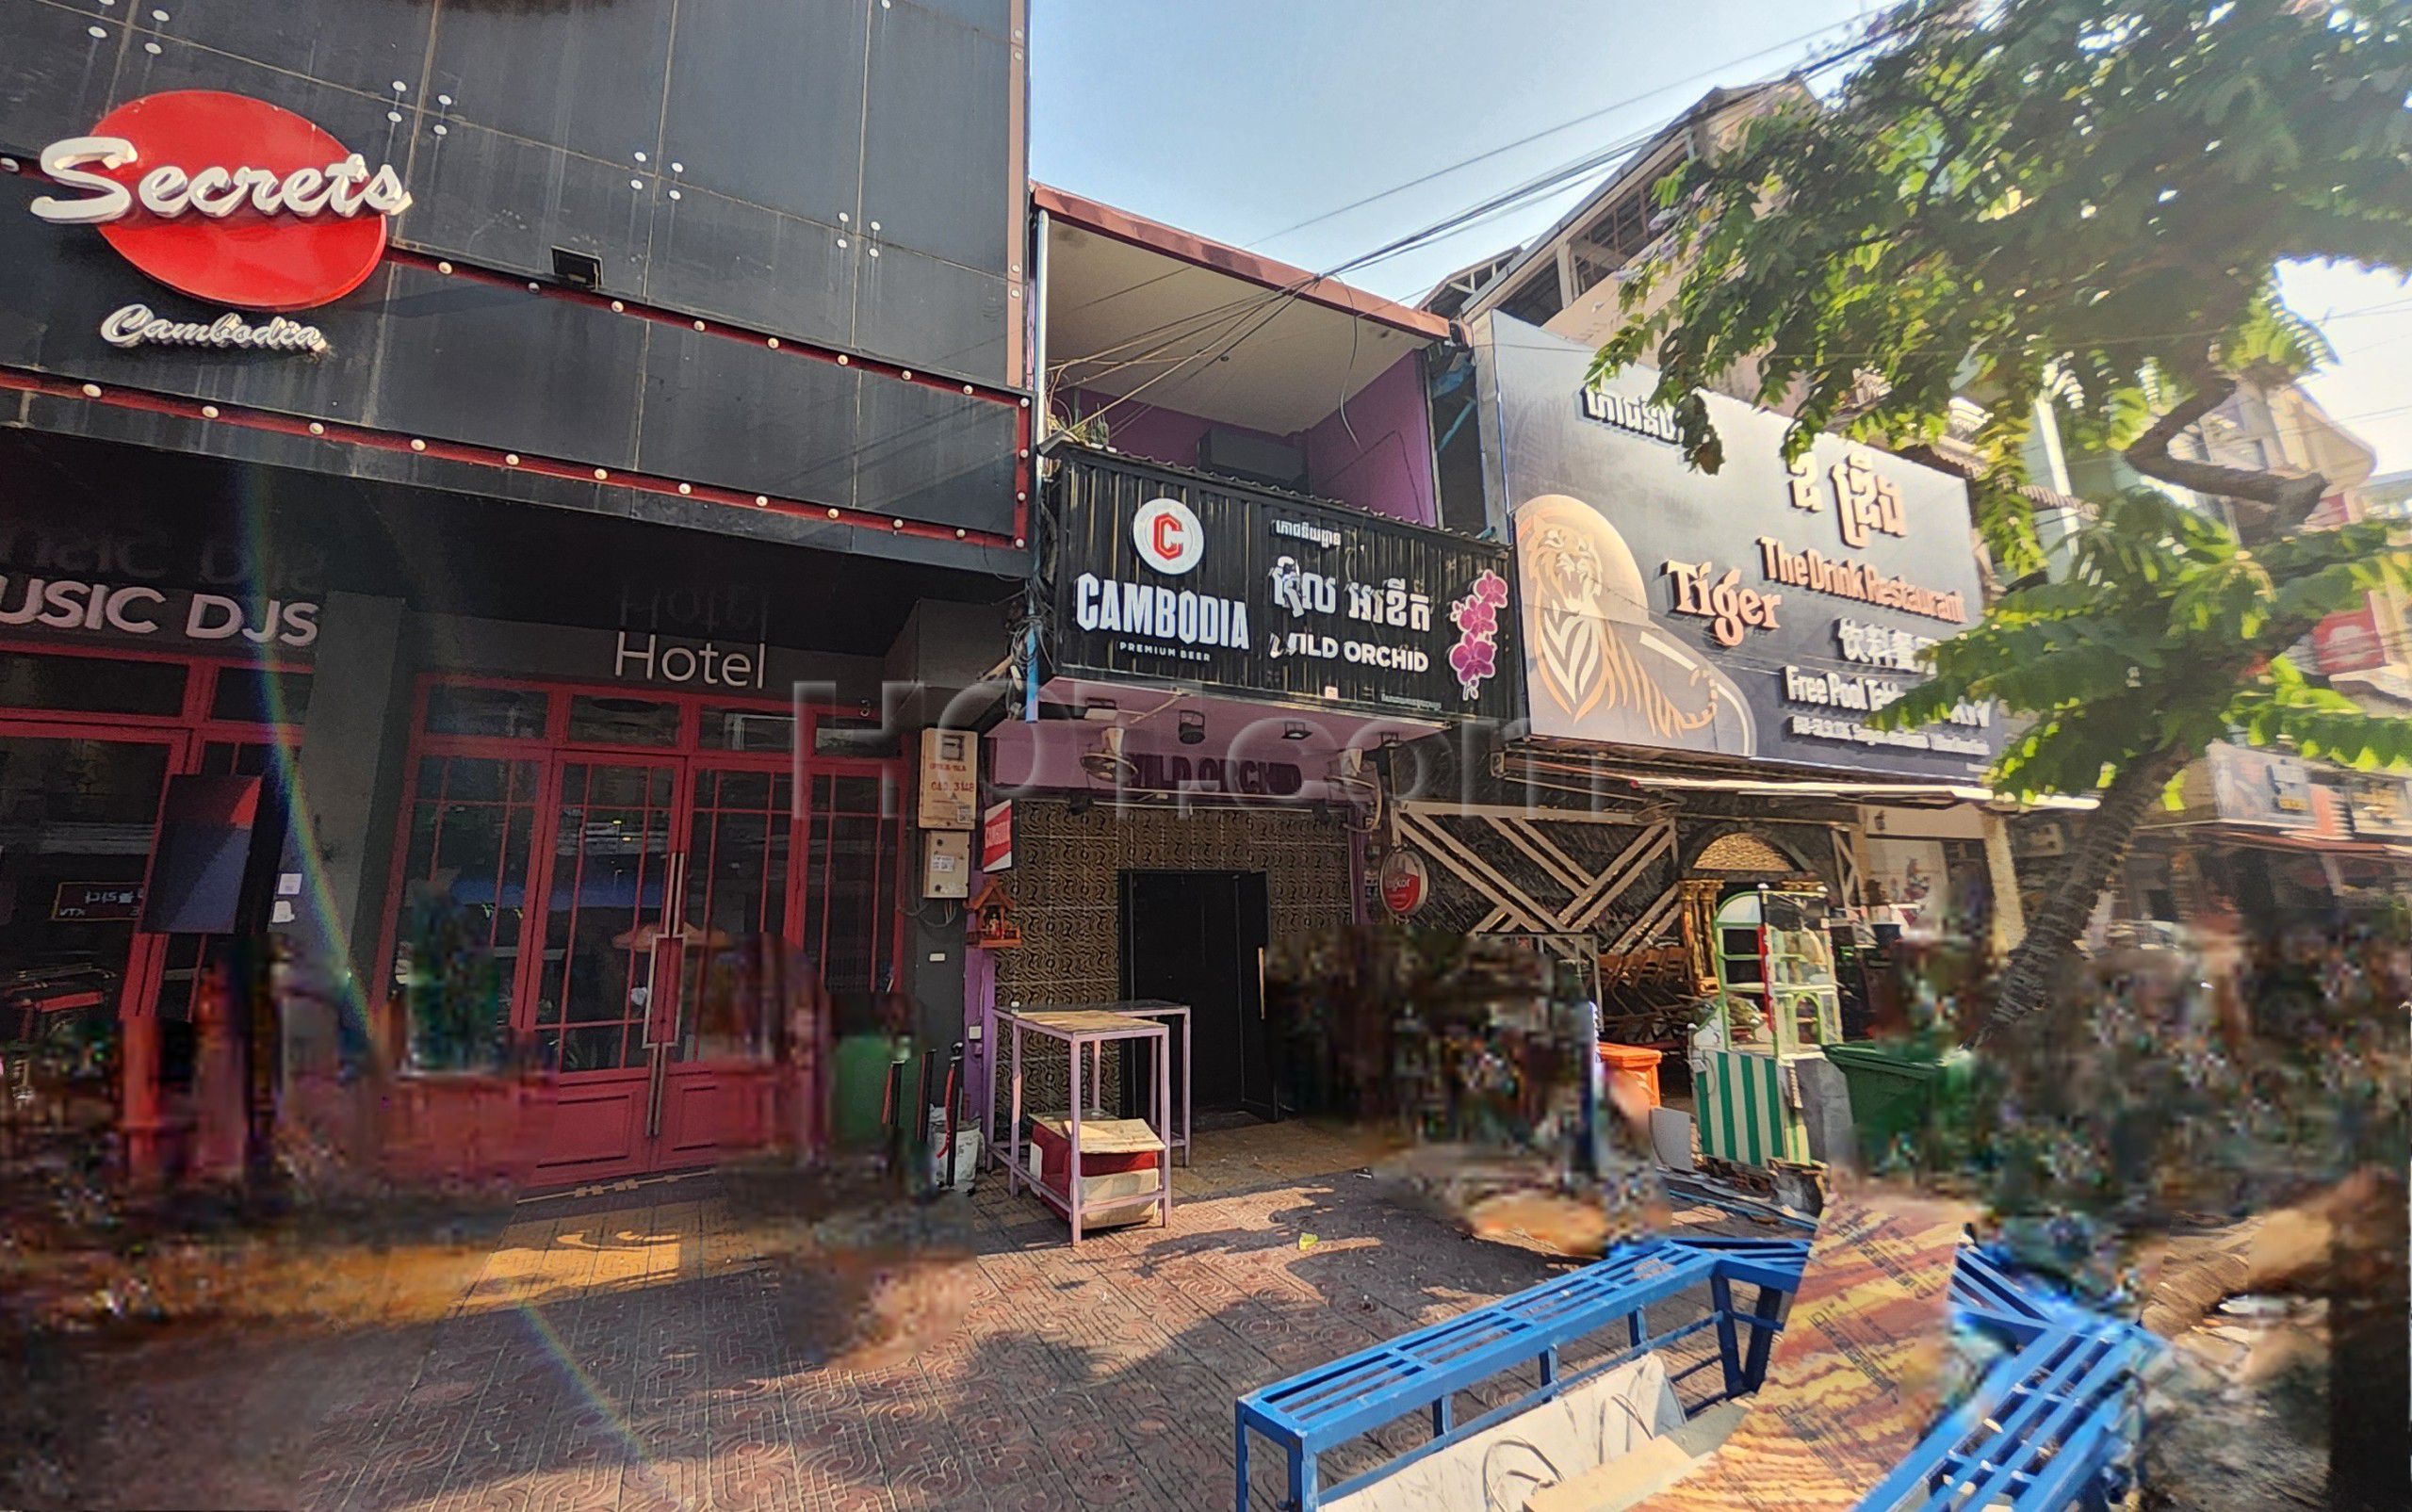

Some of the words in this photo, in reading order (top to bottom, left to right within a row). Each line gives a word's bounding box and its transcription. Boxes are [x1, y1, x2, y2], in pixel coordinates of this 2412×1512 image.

[30, 136, 412, 224] Secrets
[100, 303, 330, 354] Cambodia
[1667, 559, 1782, 647] Tiger
[1760, 536, 1809, 586] The
[1808, 548, 1869, 602] Drink
[1865, 564, 1969, 625] Restaurant
[186, 592, 320, 646] DJS
[1076, 572, 1250, 650] CAMBODIA
[614, 630, 766, 690] Hotel
[1119, 642, 1176, 657] PREMIUM
[1180, 649, 1211, 661] BEER
[1343, 641, 1429, 673] ORCHID
[1785, 665, 1828, 705] Free
